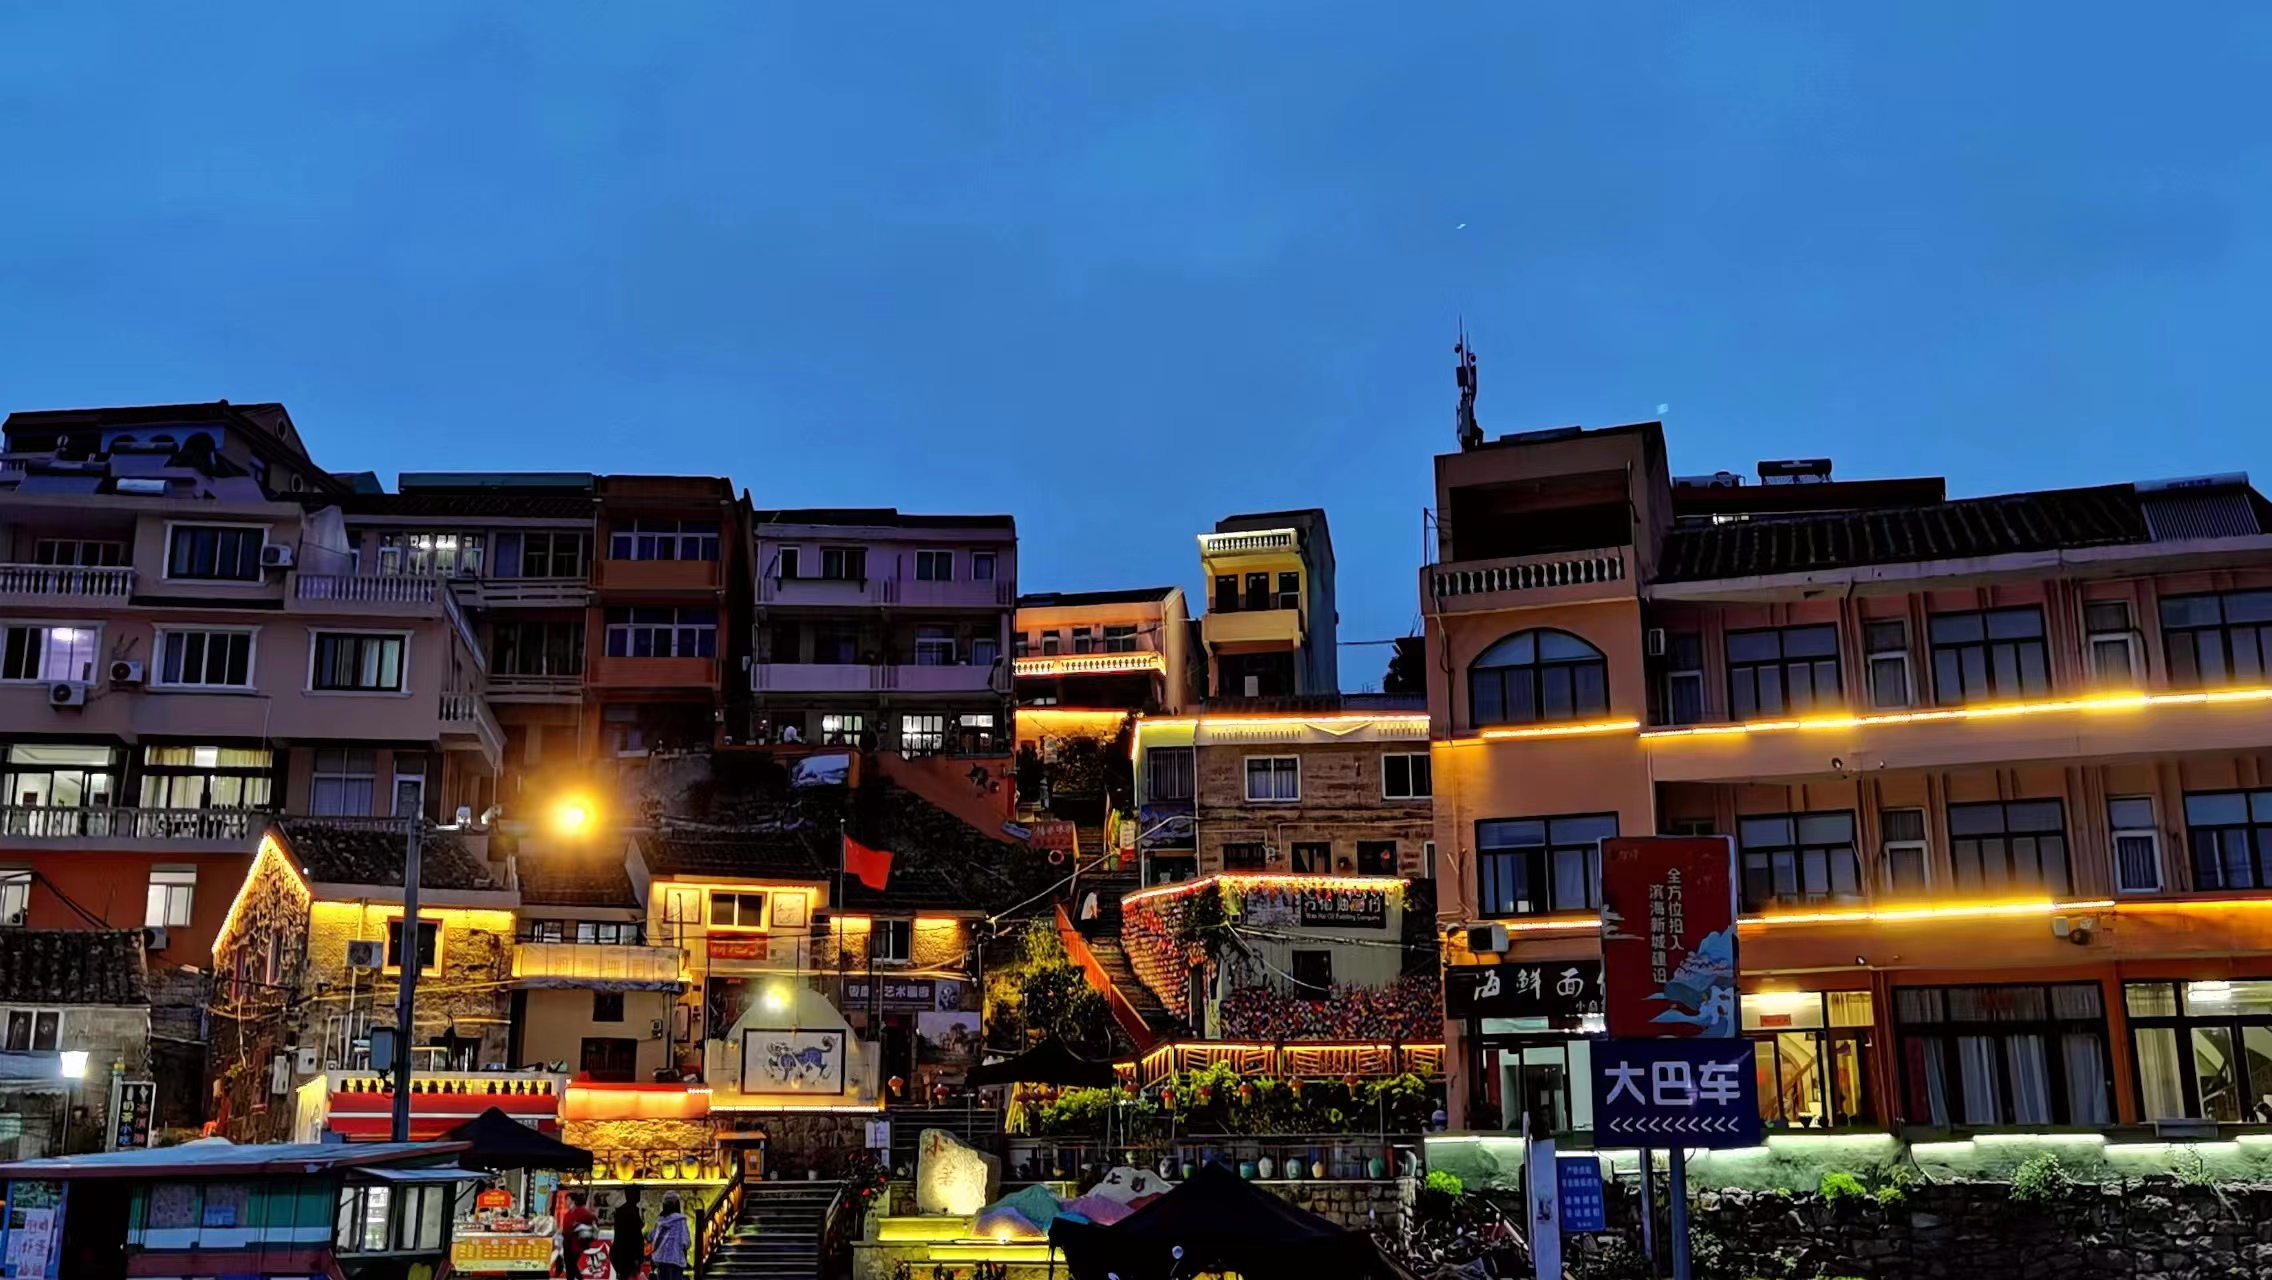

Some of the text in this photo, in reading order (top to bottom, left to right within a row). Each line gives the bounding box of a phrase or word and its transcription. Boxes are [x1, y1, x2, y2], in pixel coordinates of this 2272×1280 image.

[1474, 967, 1606, 1001] 海鲜面
[1604, 1060, 1741, 1105] 大巴车
